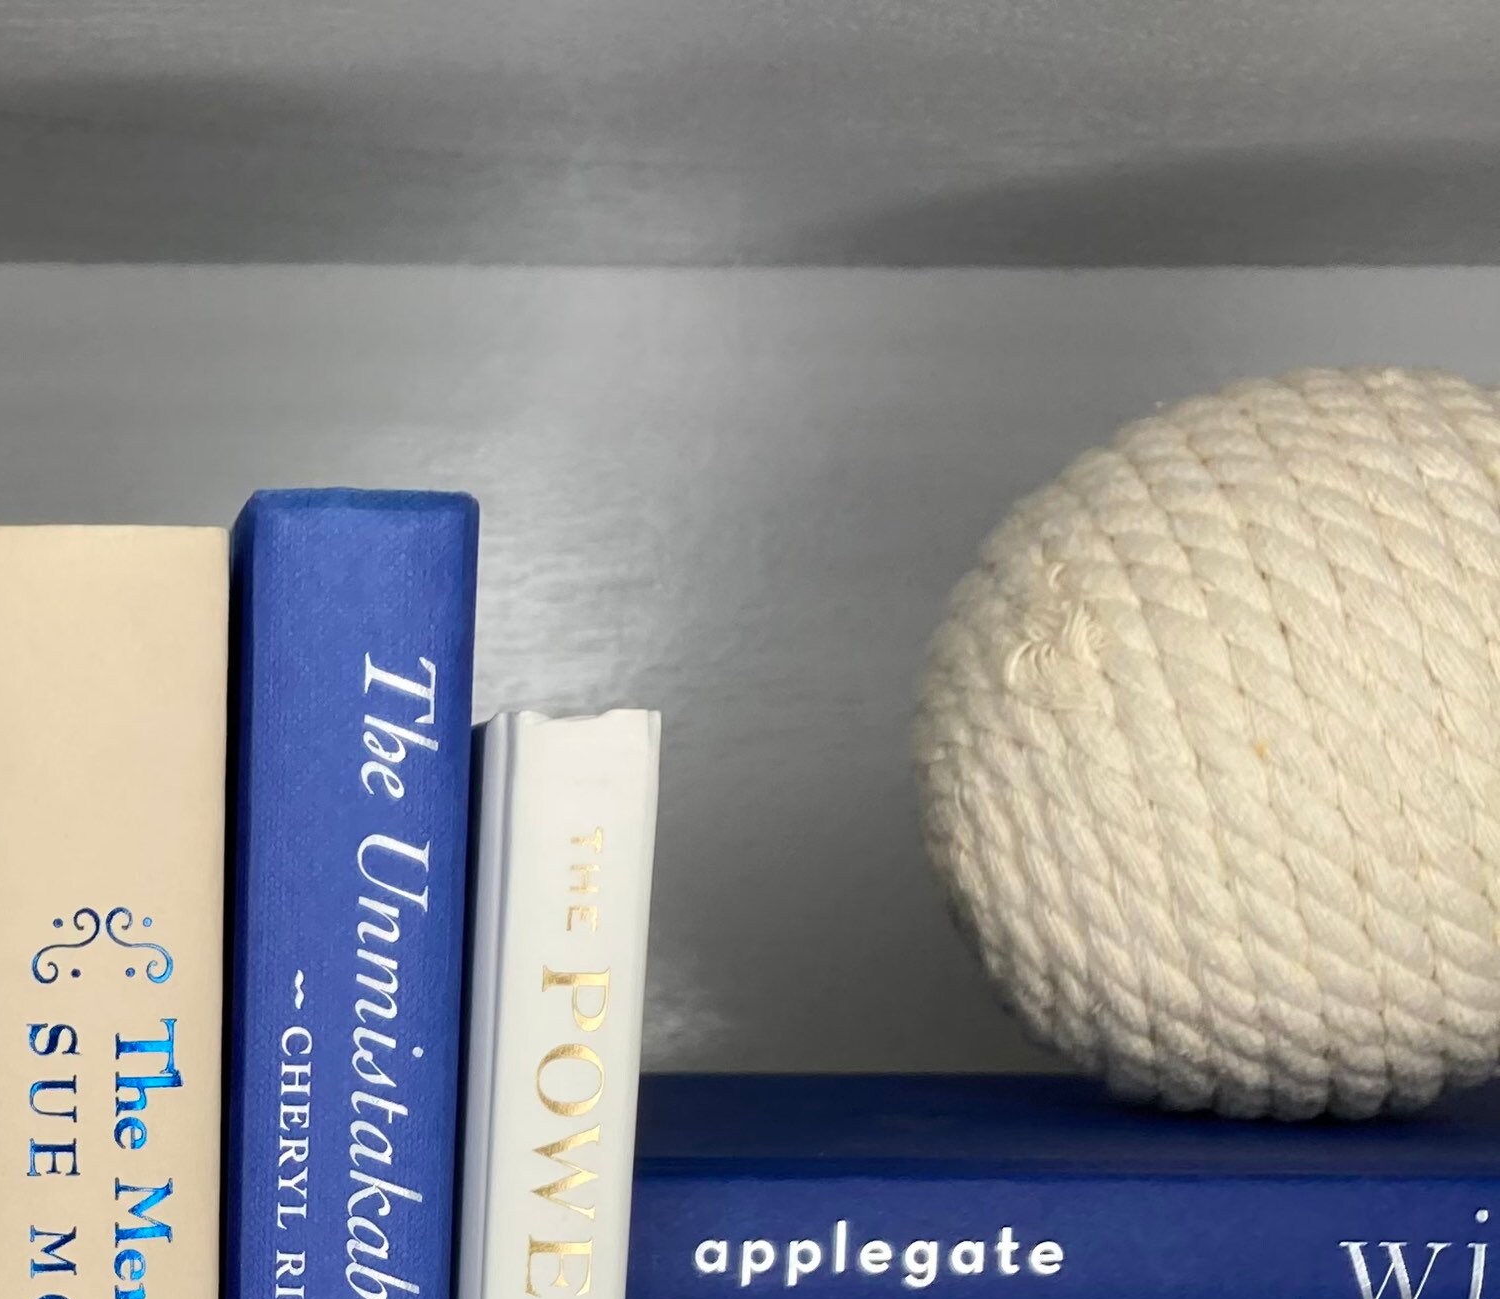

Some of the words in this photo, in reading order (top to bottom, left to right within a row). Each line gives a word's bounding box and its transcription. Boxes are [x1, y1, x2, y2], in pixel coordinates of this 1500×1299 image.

[359, 651, 439, 800] The
[565, 826, 604, 933] THE
[25, 1021, 82, 1177] SUE
[112, 1017, 185, 1151] The
[276, 1026, 313, 1230] CHERYL
[692, 1219, 1065, 1289] applegate
